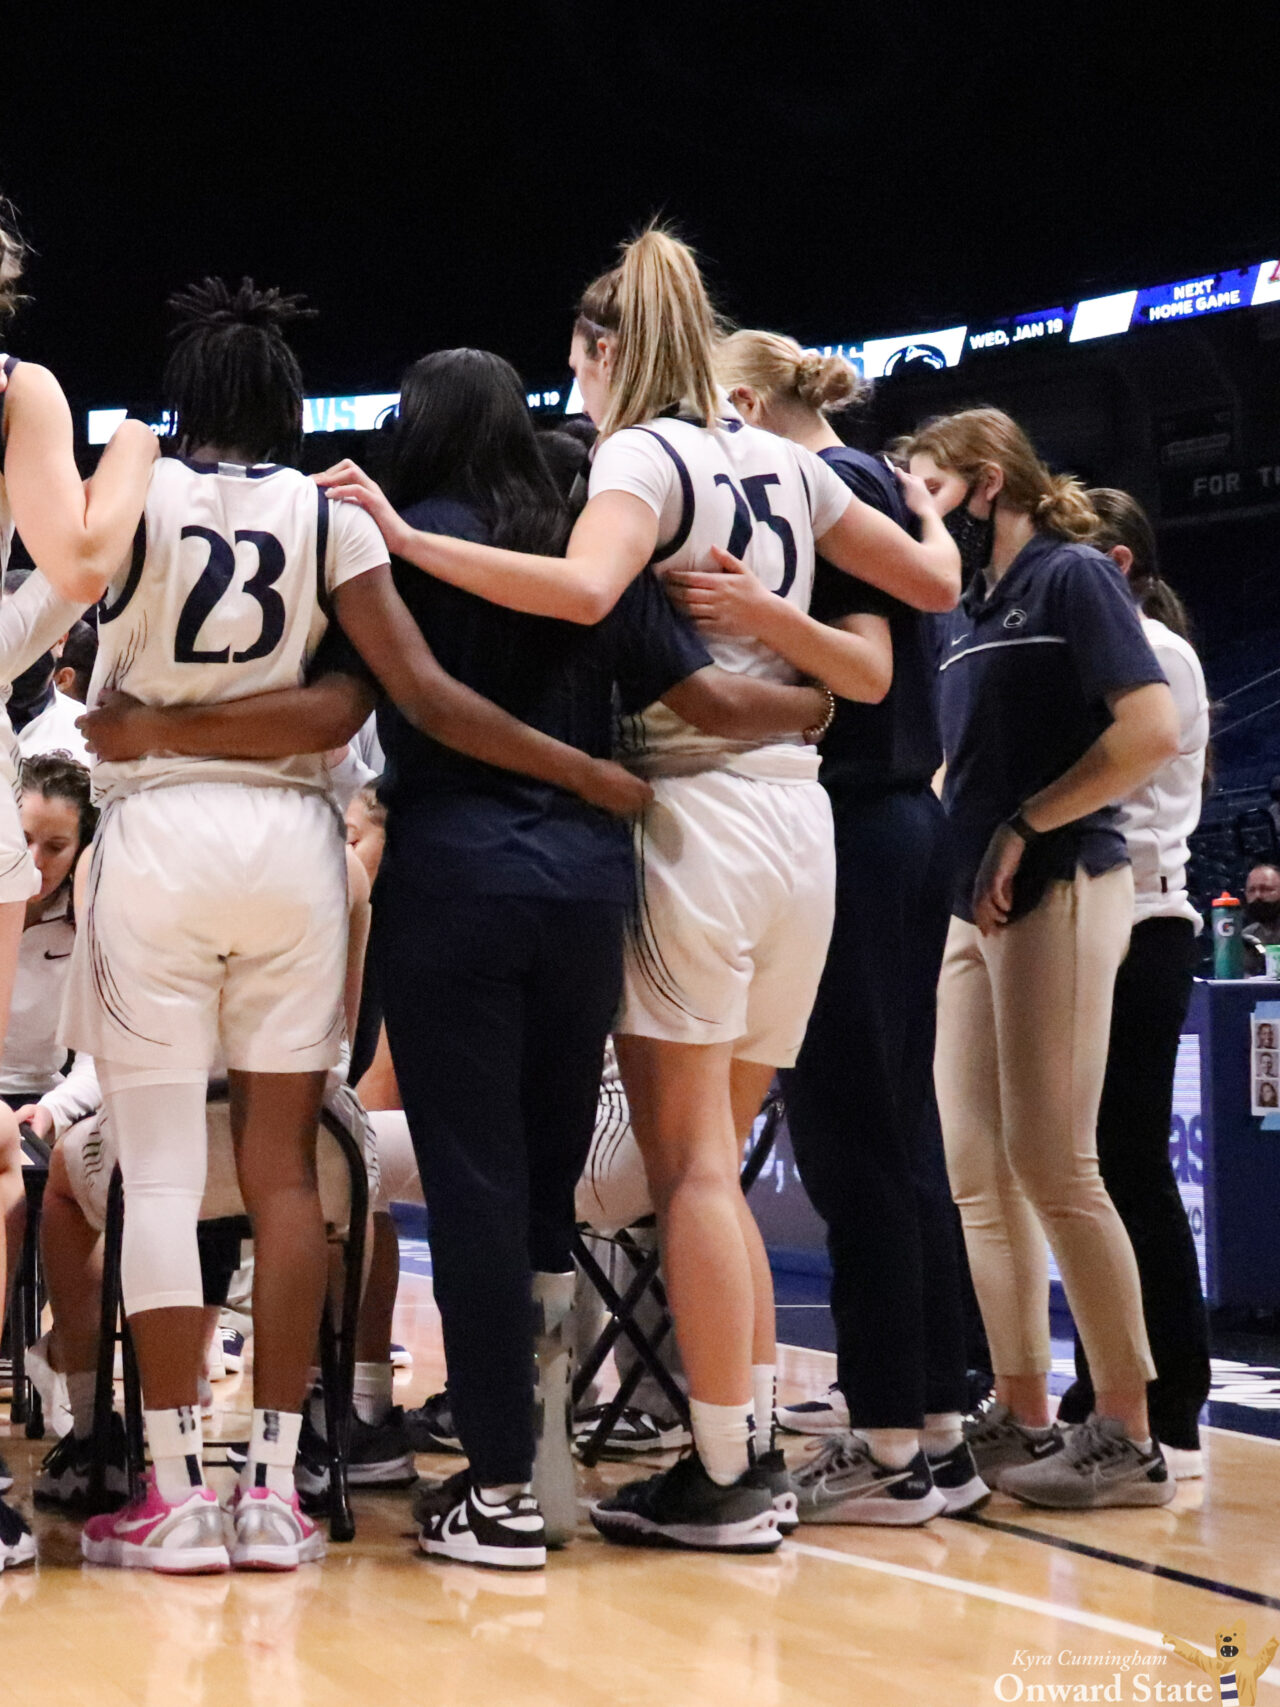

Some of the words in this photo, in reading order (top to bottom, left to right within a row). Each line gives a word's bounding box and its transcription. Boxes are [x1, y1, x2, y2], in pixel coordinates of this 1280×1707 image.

[1173, 278, 1214, 300] NEXT
[1149, 299, 1193, 321] HOME
[1195, 290, 1240, 311] GAME
[969, 330, 1009, 350] WED,
[1012, 322, 1044, 342] JAN
[1046, 318, 1063, 334] 19
[543, 391, 560, 405] 19
[1193, 472, 1241, 497] FOR
[174, 525, 286, 664] 23
[1217, 918, 1235, 936] G
